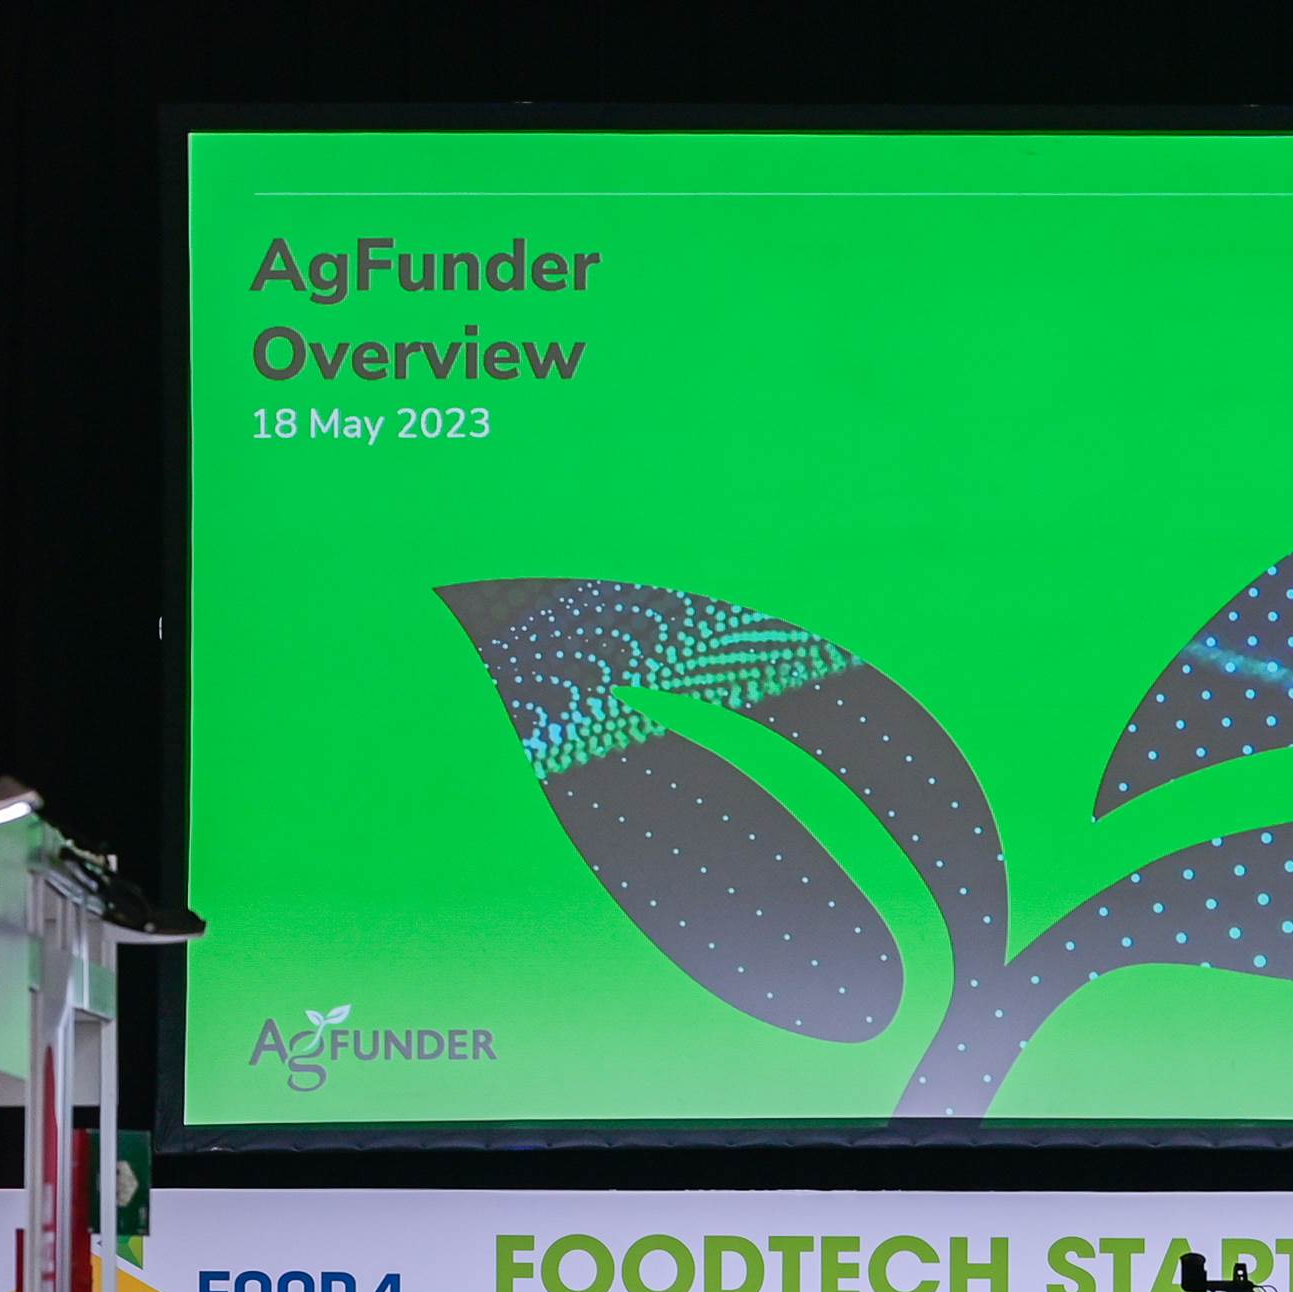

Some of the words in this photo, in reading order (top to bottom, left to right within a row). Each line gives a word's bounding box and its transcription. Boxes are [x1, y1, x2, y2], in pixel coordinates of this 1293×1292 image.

[249, 236, 602, 306] AgFunder
[252, 324, 587, 382] Overview
[252, 408, 298, 440] 18
[309, 409, 386, 446] May
[396, 407, 491, 440] 2023
